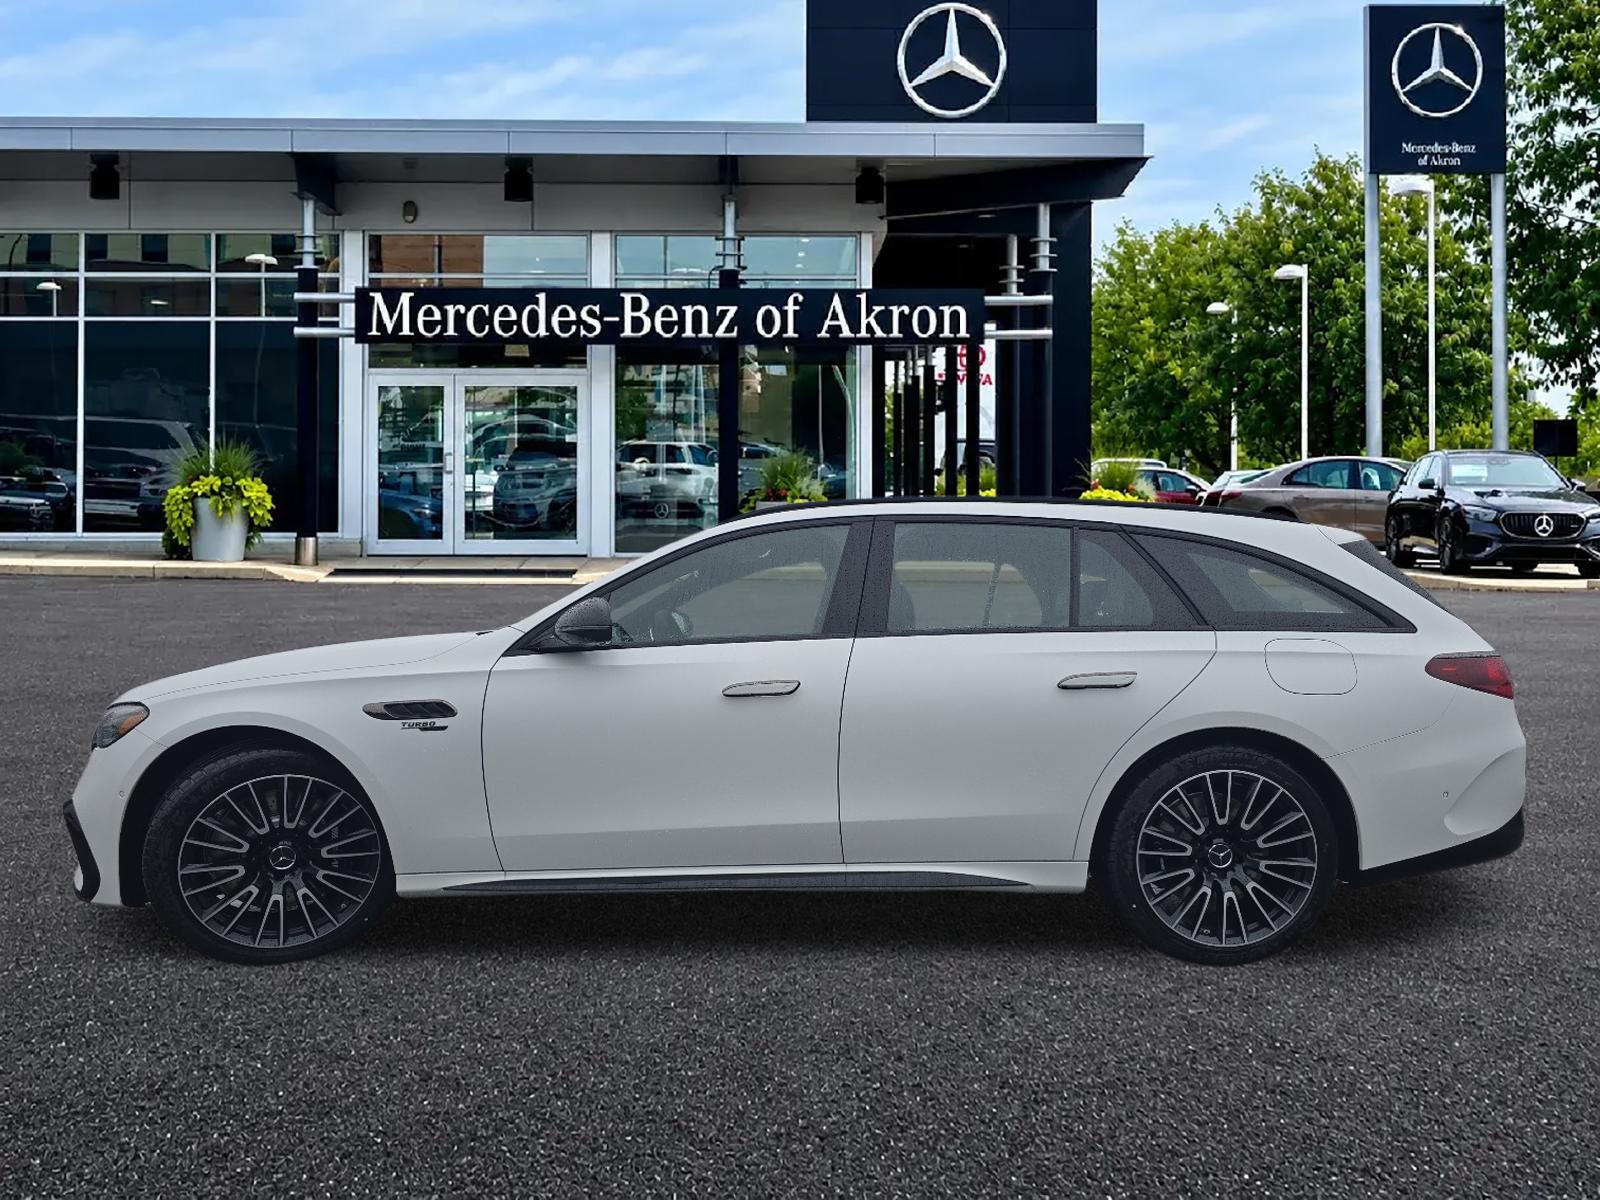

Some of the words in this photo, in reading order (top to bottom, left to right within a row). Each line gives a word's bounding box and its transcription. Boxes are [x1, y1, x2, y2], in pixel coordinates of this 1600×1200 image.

[1401, 141, 1477, 154] Mercedes-Benz
[1418, 154, 1428, 166] of
[1430, 154, 1461, 166] Akron
[367, 291, 738, 338] Mercedes-Benz
[755, 291, 803, 339] of
[817, 291, 970, 339] Akron
